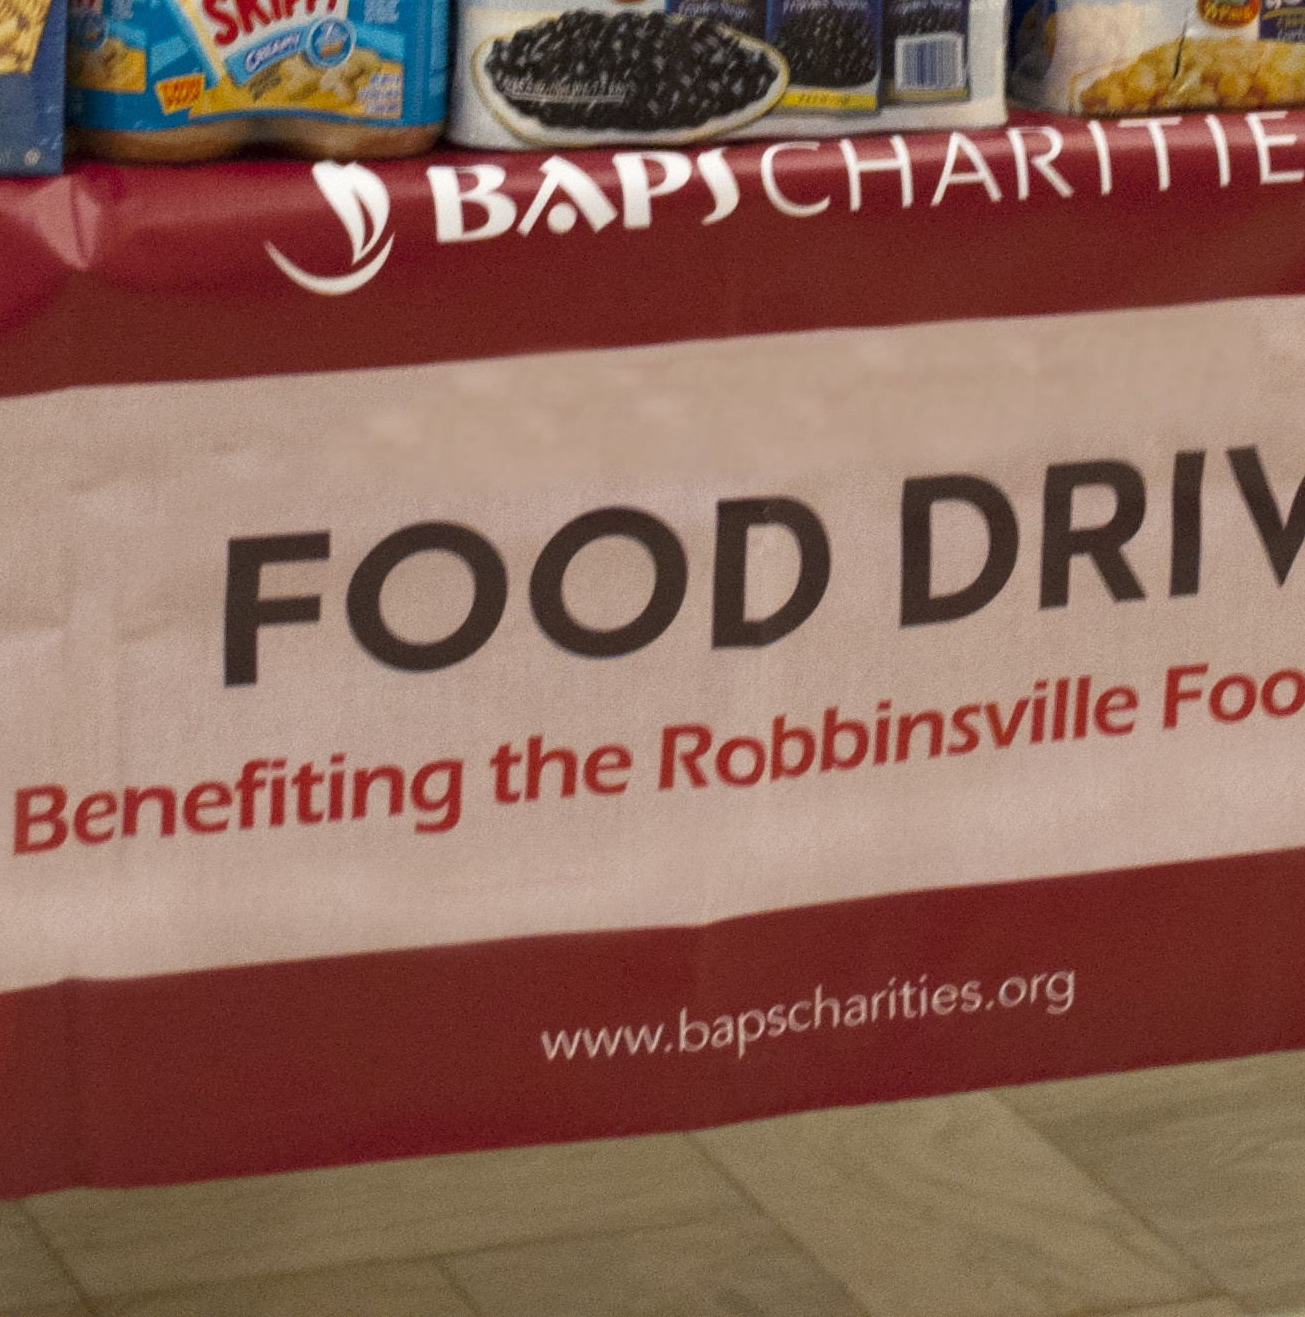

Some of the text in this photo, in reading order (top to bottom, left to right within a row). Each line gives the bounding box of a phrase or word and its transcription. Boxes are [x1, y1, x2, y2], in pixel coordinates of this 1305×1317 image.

[428, 150, 740, 242] BAPS
[222, 494, 831, 688] FOOD
[11, 749, 466, 854] Benefiting
[489, 732, 633, 804] the
[658, 676, 1139, 792] Robbinsville
[540, 968, 1078, 1061] www.bapscharities.org
